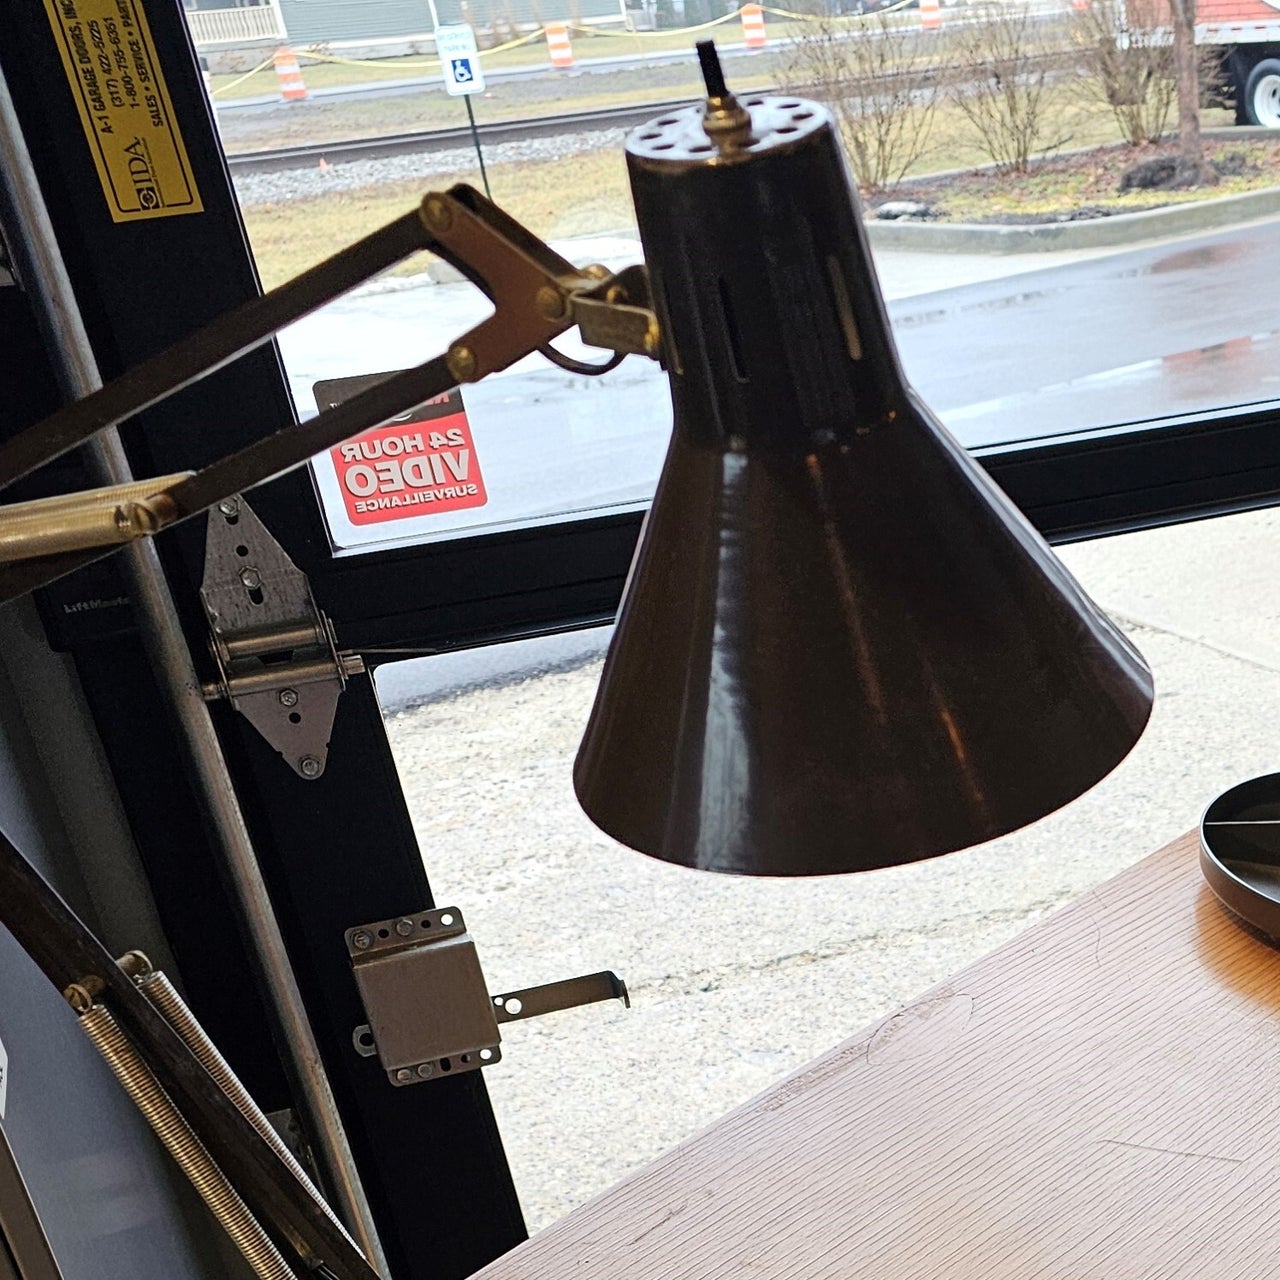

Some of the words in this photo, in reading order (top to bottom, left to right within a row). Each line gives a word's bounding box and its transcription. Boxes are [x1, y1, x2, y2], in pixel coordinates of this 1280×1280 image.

[68, 21, 91, 64] DOORS,
[103, 16, 140, 109] 1-800-755-6351
[128, 38, 151, 83] SERVICE
[82, 68, 107, 114] GARAGE
[105, 79, 125, 108] (317)
[148, 94, 164, 127] SALES
[98, 115, 114, 134] A-1
